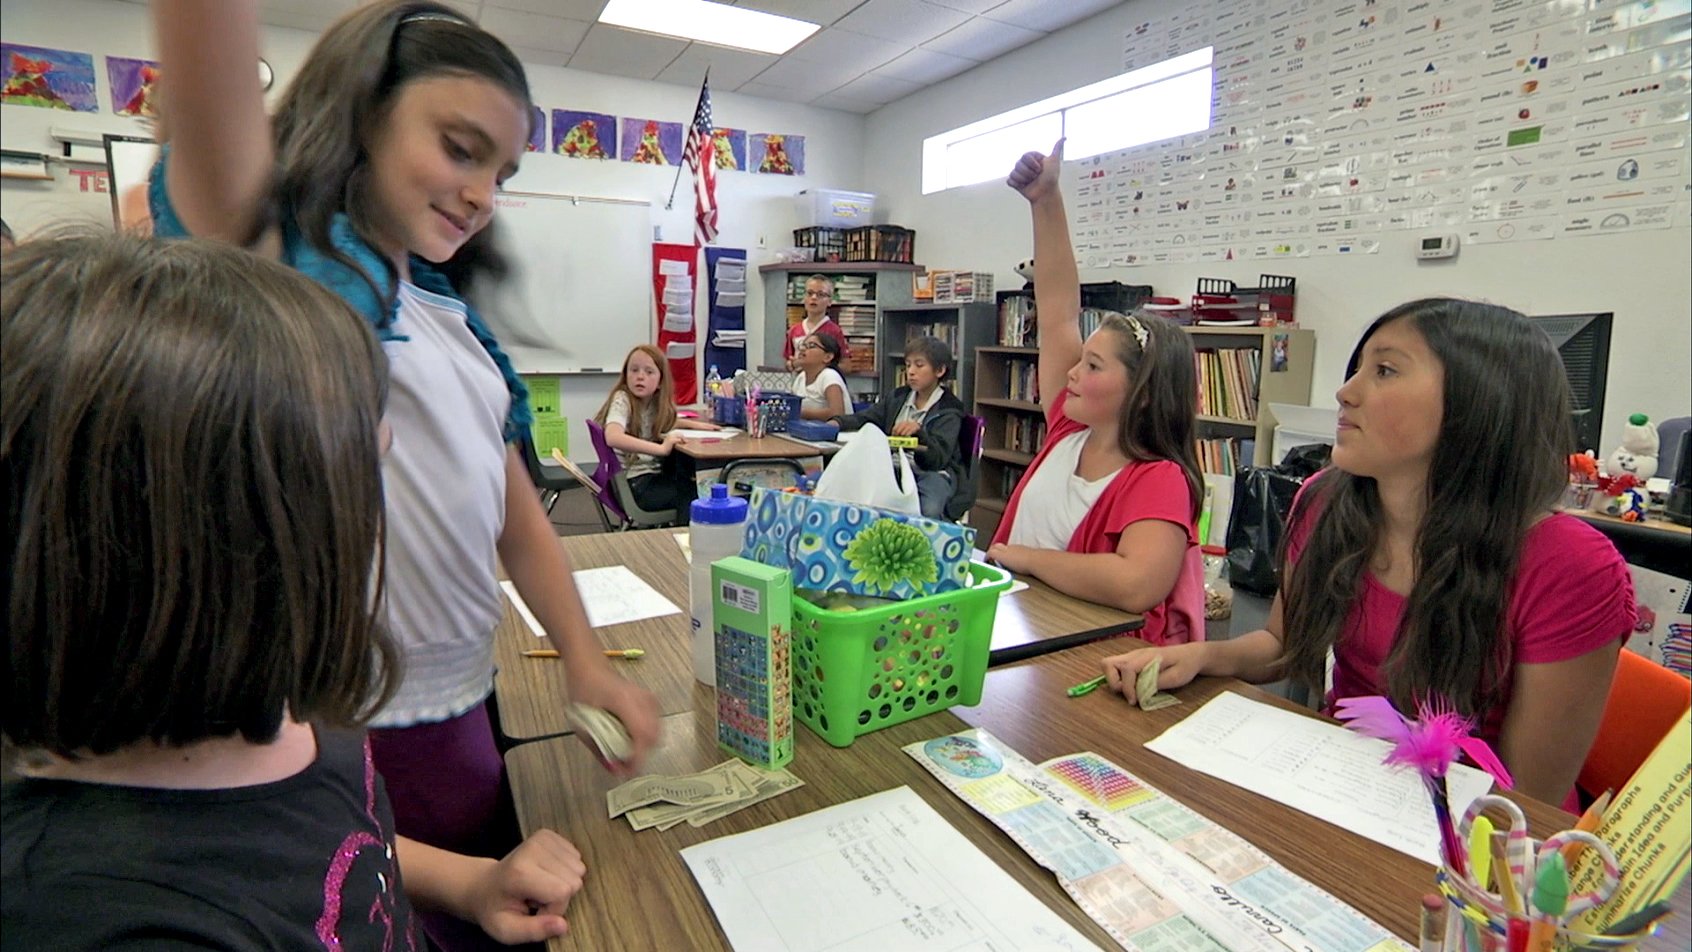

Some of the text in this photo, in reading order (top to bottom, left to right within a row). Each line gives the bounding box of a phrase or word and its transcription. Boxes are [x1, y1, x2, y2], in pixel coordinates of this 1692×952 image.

[1595, 786, 1642, 838] Paragraphs
[1615, 803, 1663, 861] derstanding
[1659, 784, 1677, 804] and
[1573, 831, 1622, 895] range Chnks
[1618, 858, 1637, 881] Main
[1631, 832, 1655, 858] Idea
[1653, 813, 1671, 833] and
[1596, 843, 1666, 934] Summarize Chunks
